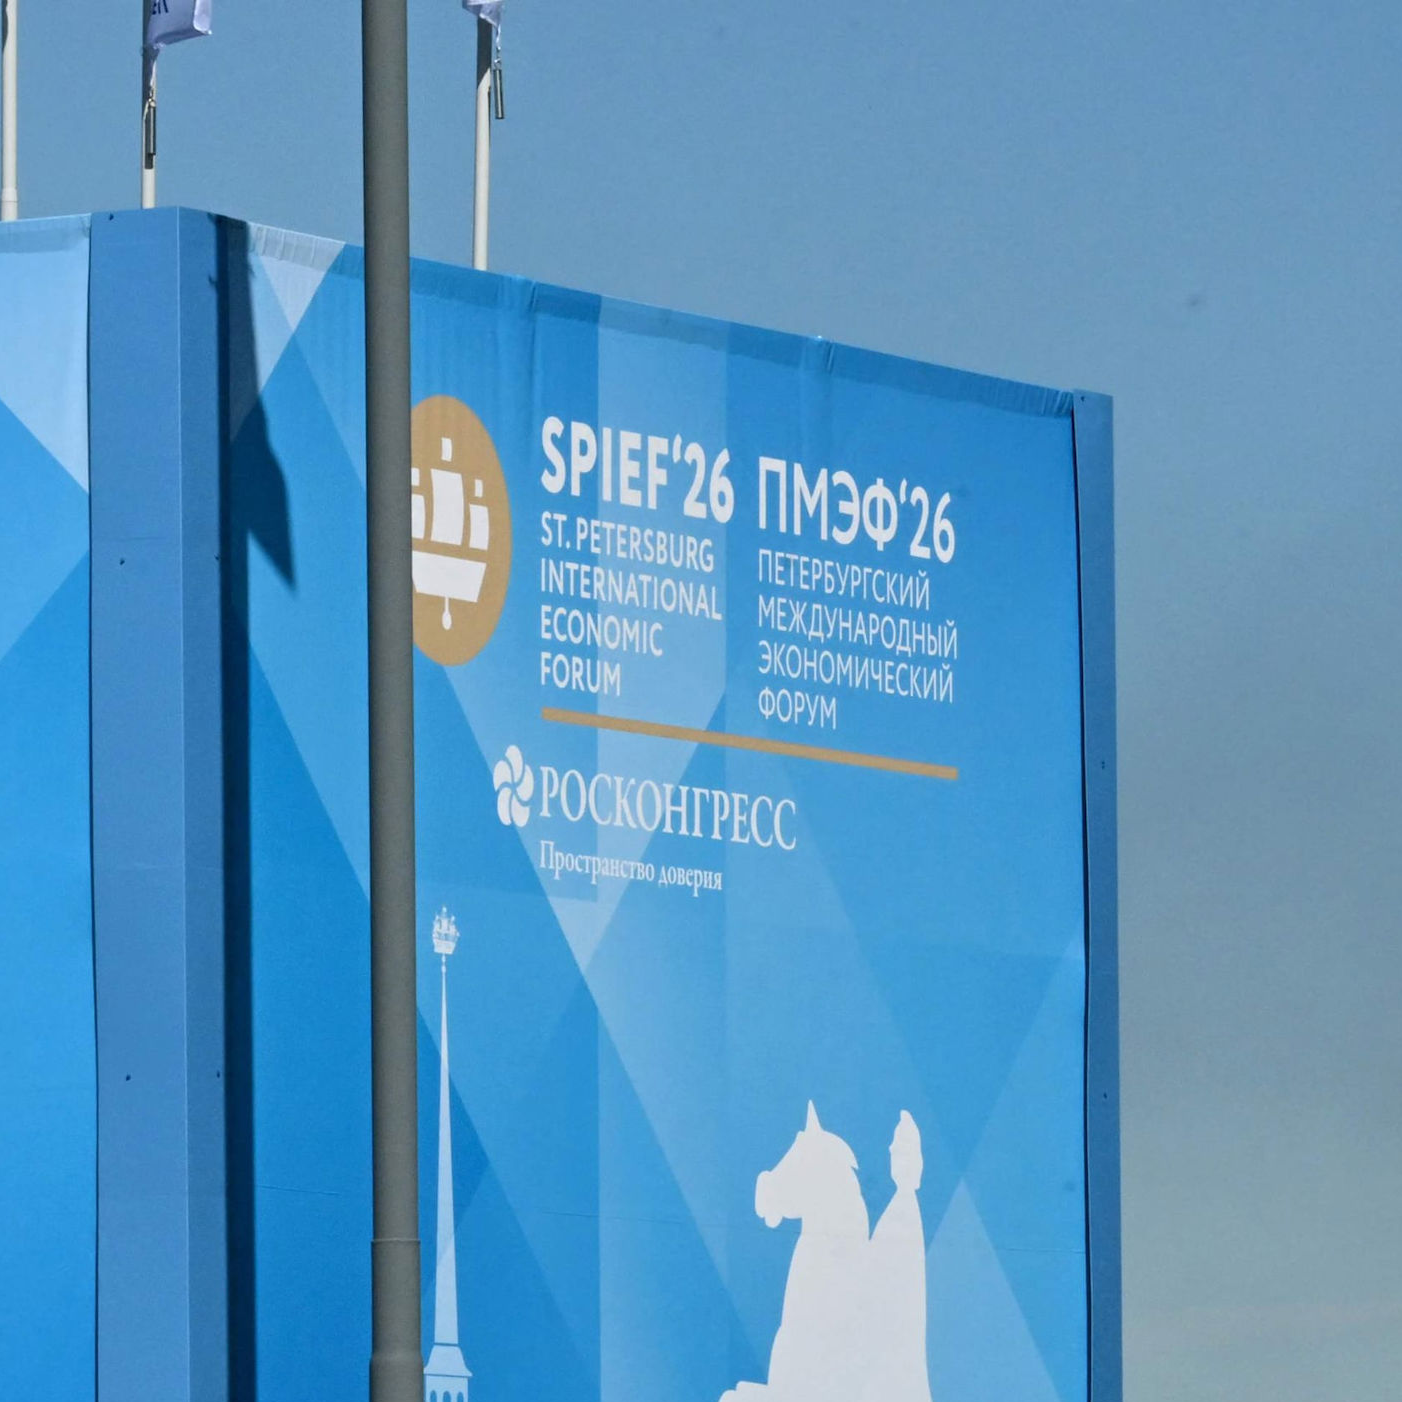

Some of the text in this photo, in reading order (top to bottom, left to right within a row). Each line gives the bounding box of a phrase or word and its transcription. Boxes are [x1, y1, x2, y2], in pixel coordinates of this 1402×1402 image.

[540, 510, 716, 574] ST. PETERSBURG
[540, 557, 724, 622] INTERNATIONAL
[758, 547, 930, 612] ПЕТЕРБУРГСКИЙ
[540, 604, 664, 658] ECONOMIC
[758, 593, 958, 661] МЕЖДУНАРОДНЫЙ
[540, 651, 622, 698] FORUM
[758, 638, 954, 705] ЭКОНОМИЧЕСКИЙ
[758, 685, 838, 731] ФОРУМ
[539, 764, 798, 852] РОСКОНГРЕСС
[539, 838, 724, 898] Пространство доверия
